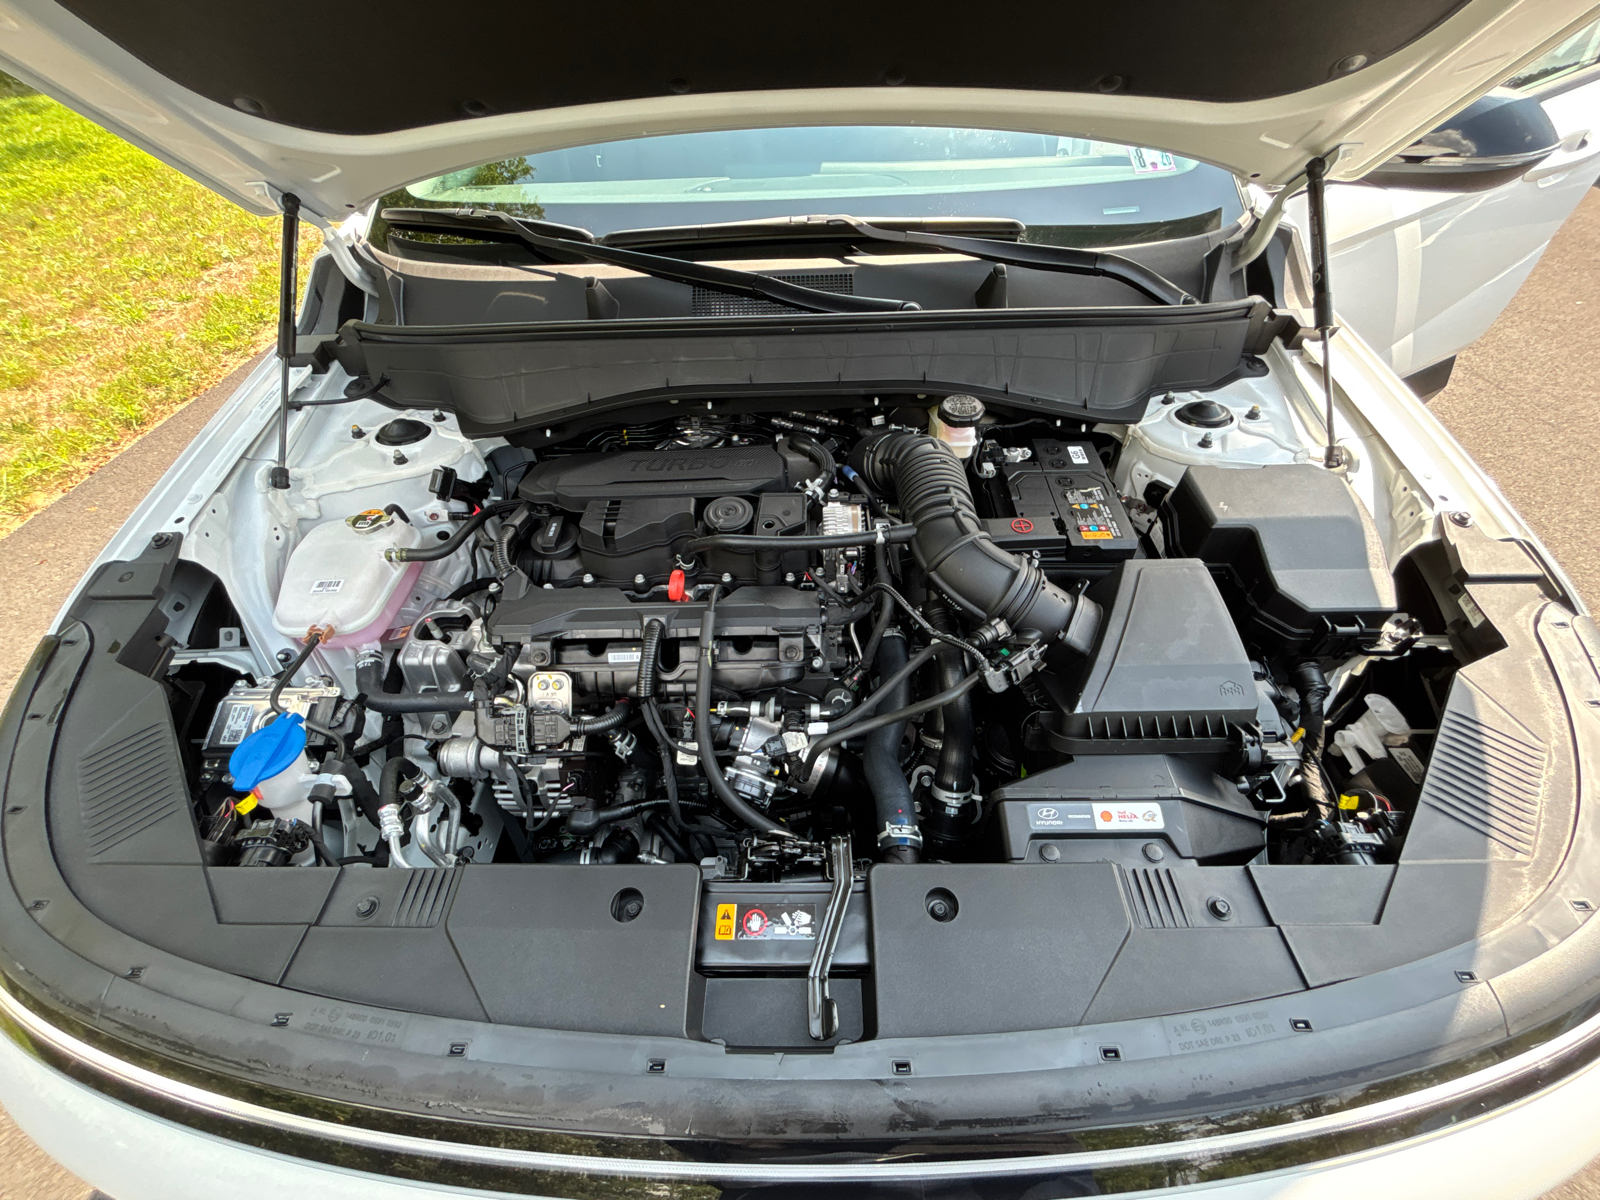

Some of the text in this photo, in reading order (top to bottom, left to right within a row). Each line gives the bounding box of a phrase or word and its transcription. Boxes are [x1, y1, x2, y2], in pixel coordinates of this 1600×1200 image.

[1135, 148, 1146, 168] 8
[630, 456, 732, 472] TURBO
[1178, 1042, 1195, 1051] DOT
[1195, 1038, 1209, 1048] SAE
[1211, 1036, 1223, 1046] DRL
